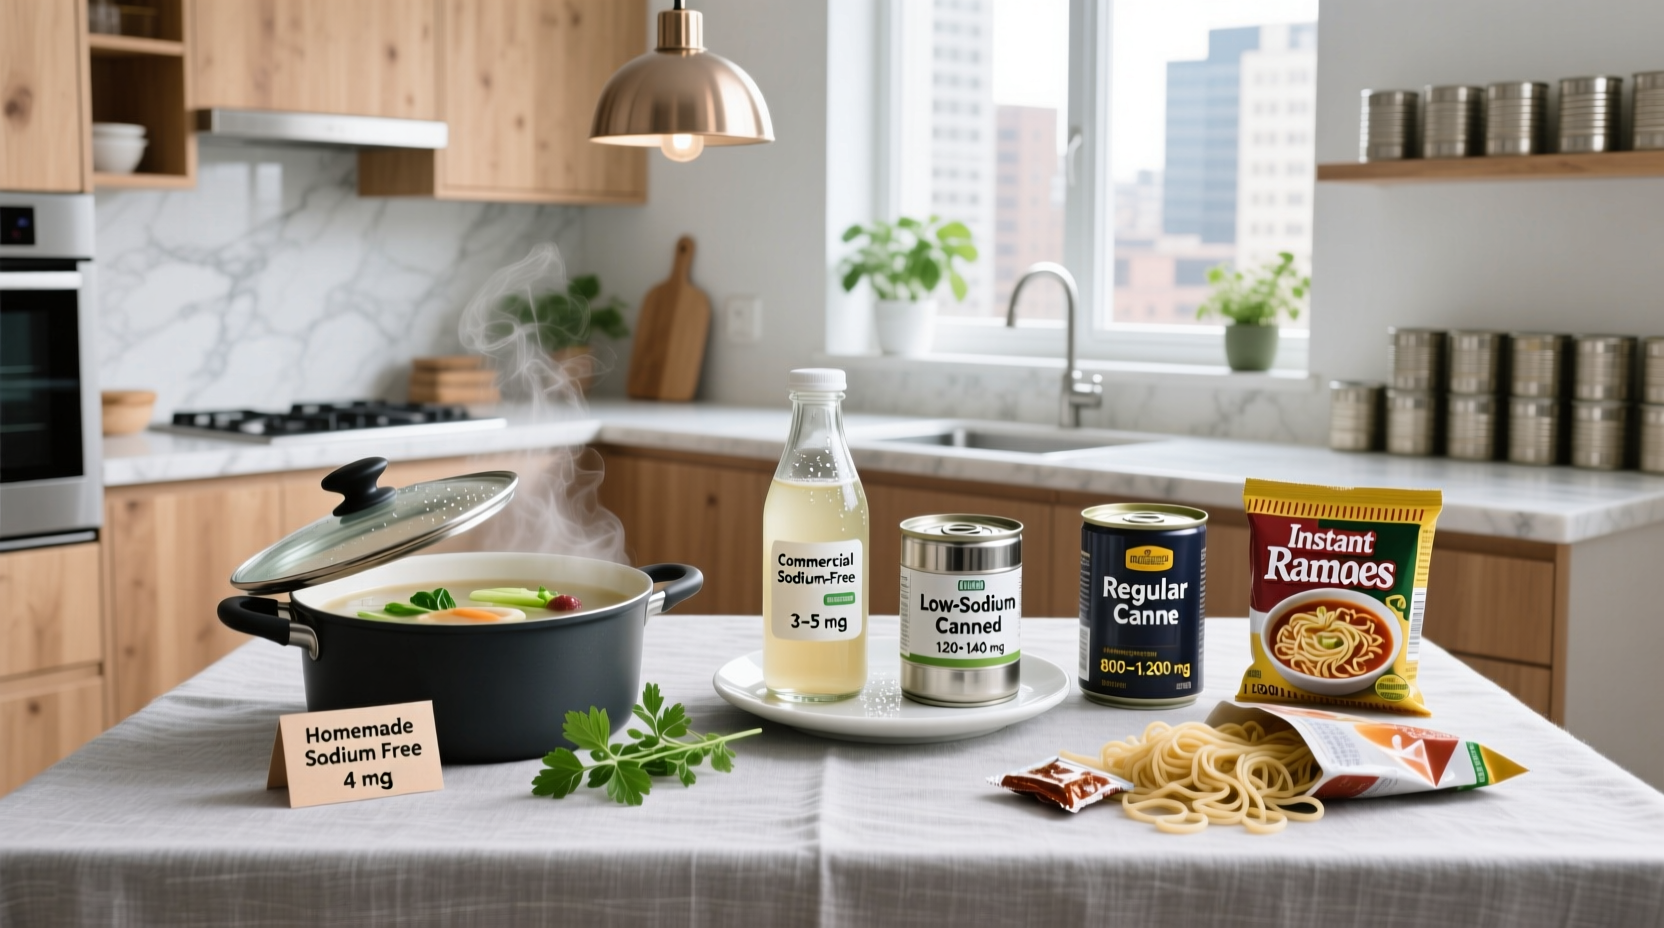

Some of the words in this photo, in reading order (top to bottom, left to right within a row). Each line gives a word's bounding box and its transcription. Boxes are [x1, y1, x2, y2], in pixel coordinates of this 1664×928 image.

[1287, 523, 1375, 554] Instant
[777, 552, 854, 568] Commercial
[777, 570, 856, 585] Sodium-Free
[1102, 575, 1188, 606] Regular
[920, 593, 1016, 613] Low-Sodium
[935, 614, 1002, 634] Canned
[1113, 603, 1179, 625] Canne
[824, 617, 848, 632] mg
[989, 643, 1005, 655] mg
[1174, 663, 1191, 678] mg
[305, 717, 414, 744] Homemade
[305, 746, 376, 767] Sodium
[381, 742, 422, 759] Free
[343, 771, 356, 789] 4
[362, 770, 393, 790] mg
